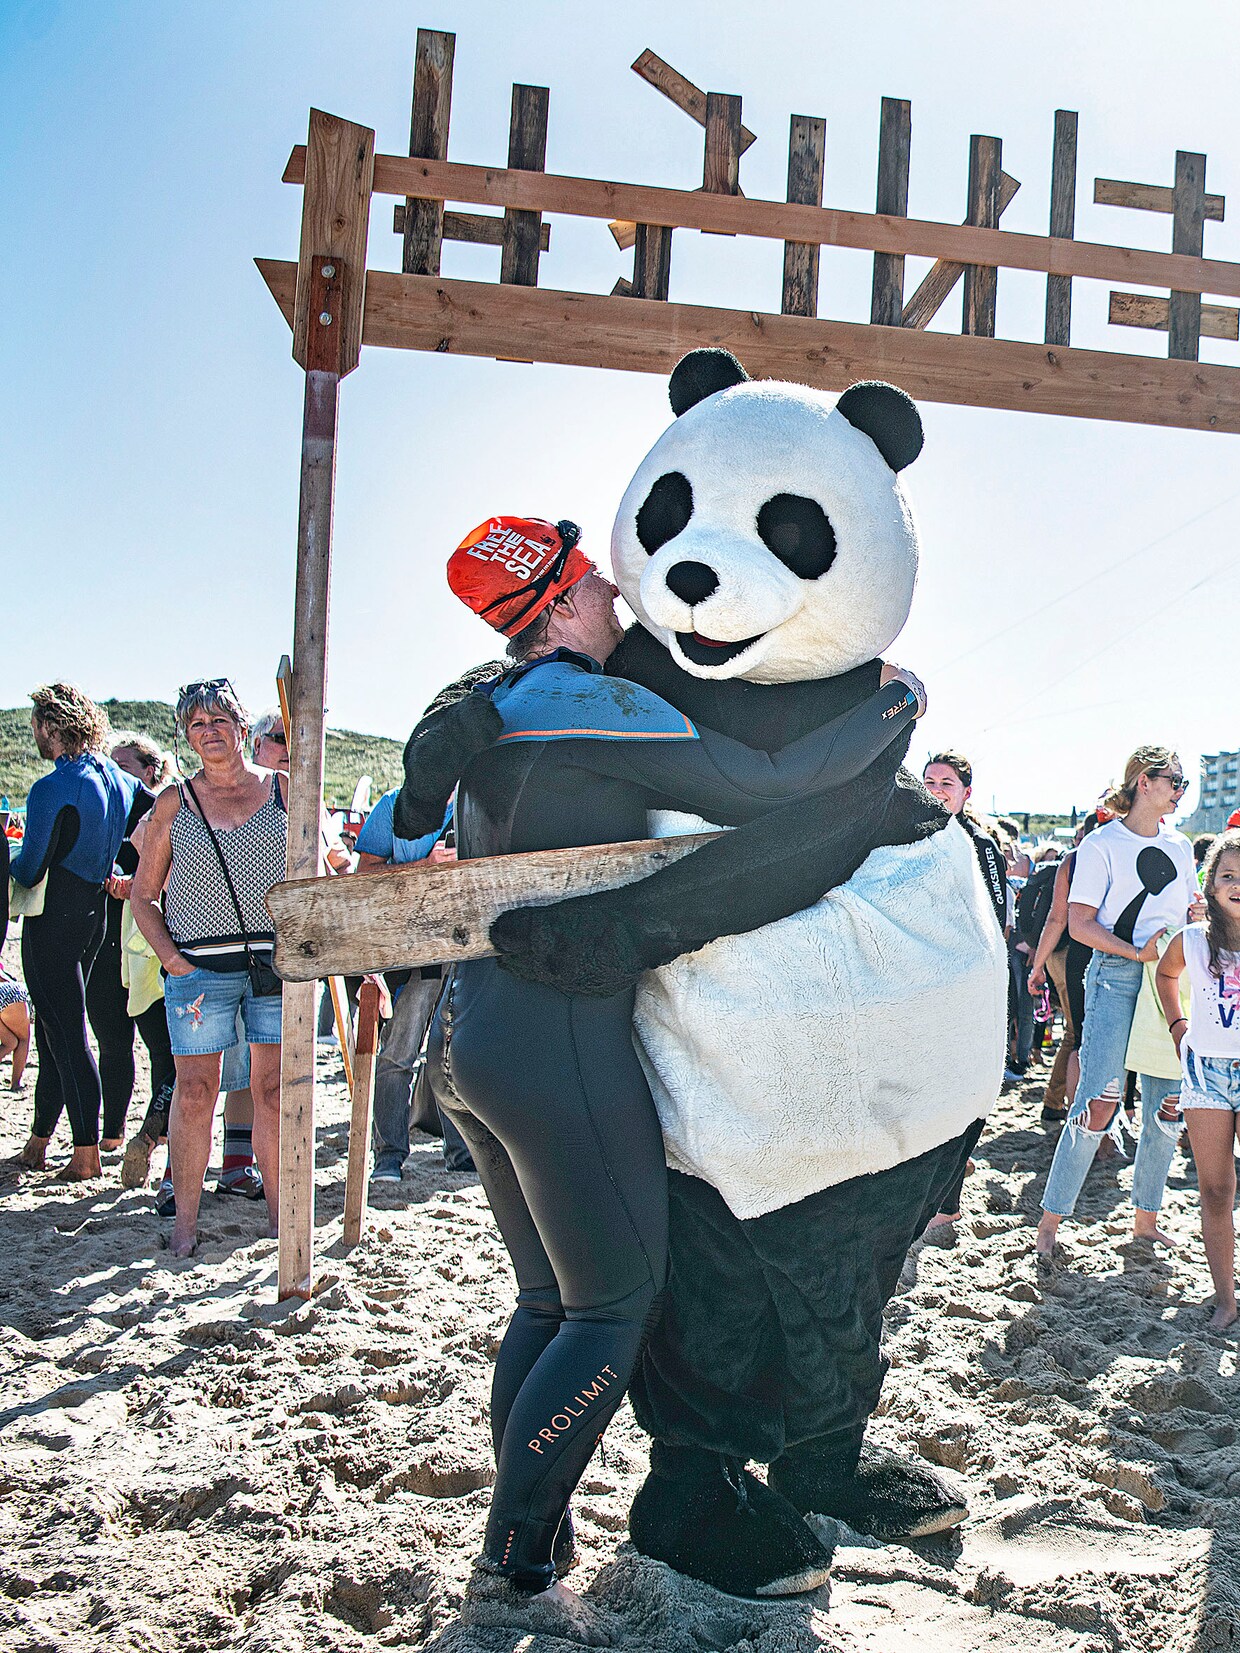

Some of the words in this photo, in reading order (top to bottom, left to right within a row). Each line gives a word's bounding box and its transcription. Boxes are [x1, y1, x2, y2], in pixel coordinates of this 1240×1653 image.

[467, 523, 513, 561] FREE
[490, 532, 526, 563] THE
[505, 538, 552, 580] SEA
[985, 846, 1004, 905] QUIKSILVER
[528, 1364, 618, 1455] PROLIMIT
